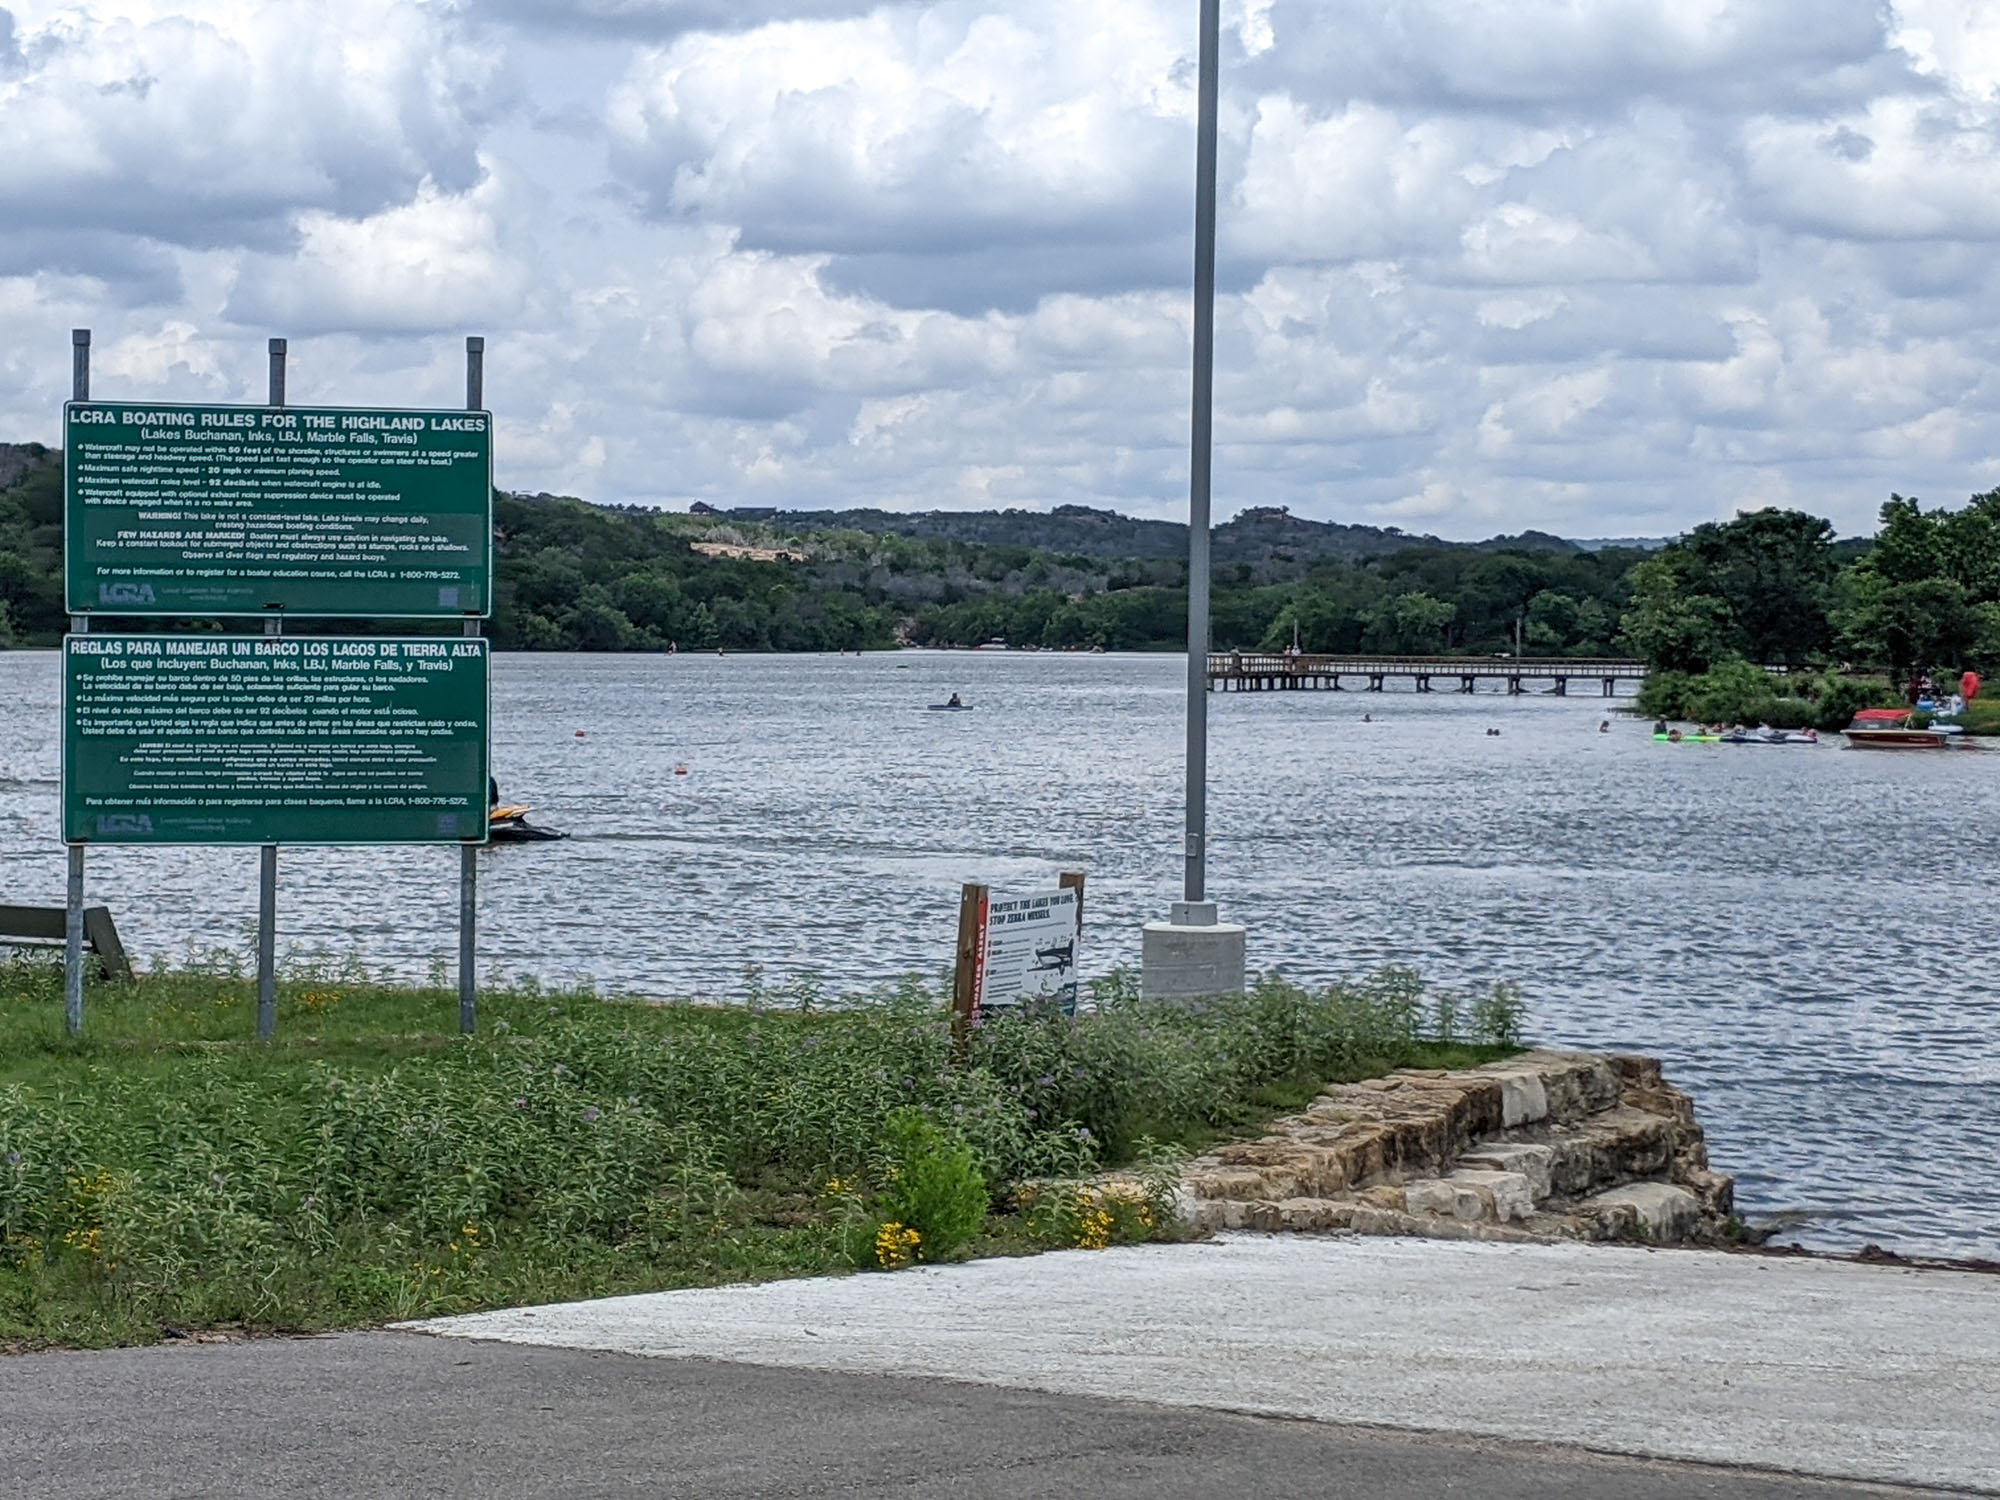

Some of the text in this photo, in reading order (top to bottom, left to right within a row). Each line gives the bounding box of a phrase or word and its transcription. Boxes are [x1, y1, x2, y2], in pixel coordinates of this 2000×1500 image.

[70, 410, 485, 431] LCRA BOATING RULES FOR THE HIGHLAND LAKES
[141, 428, 417, 444] (Lakes Buchanan, Inks, LBJ, Marble Falls, Travis)
[71, 641, 481, 656] REGLAS PARA MANEJAR UN BARCO LOS LAGOS DE TIERRA ALTA
[101, 657, 453, 672] (Los que incluyen: Buchanan, Inks, LBJ, Marble Falls, y Travis)
[990, 901, 1018, 914] PROTECT
[990, 914, 1006, 926] STOP
